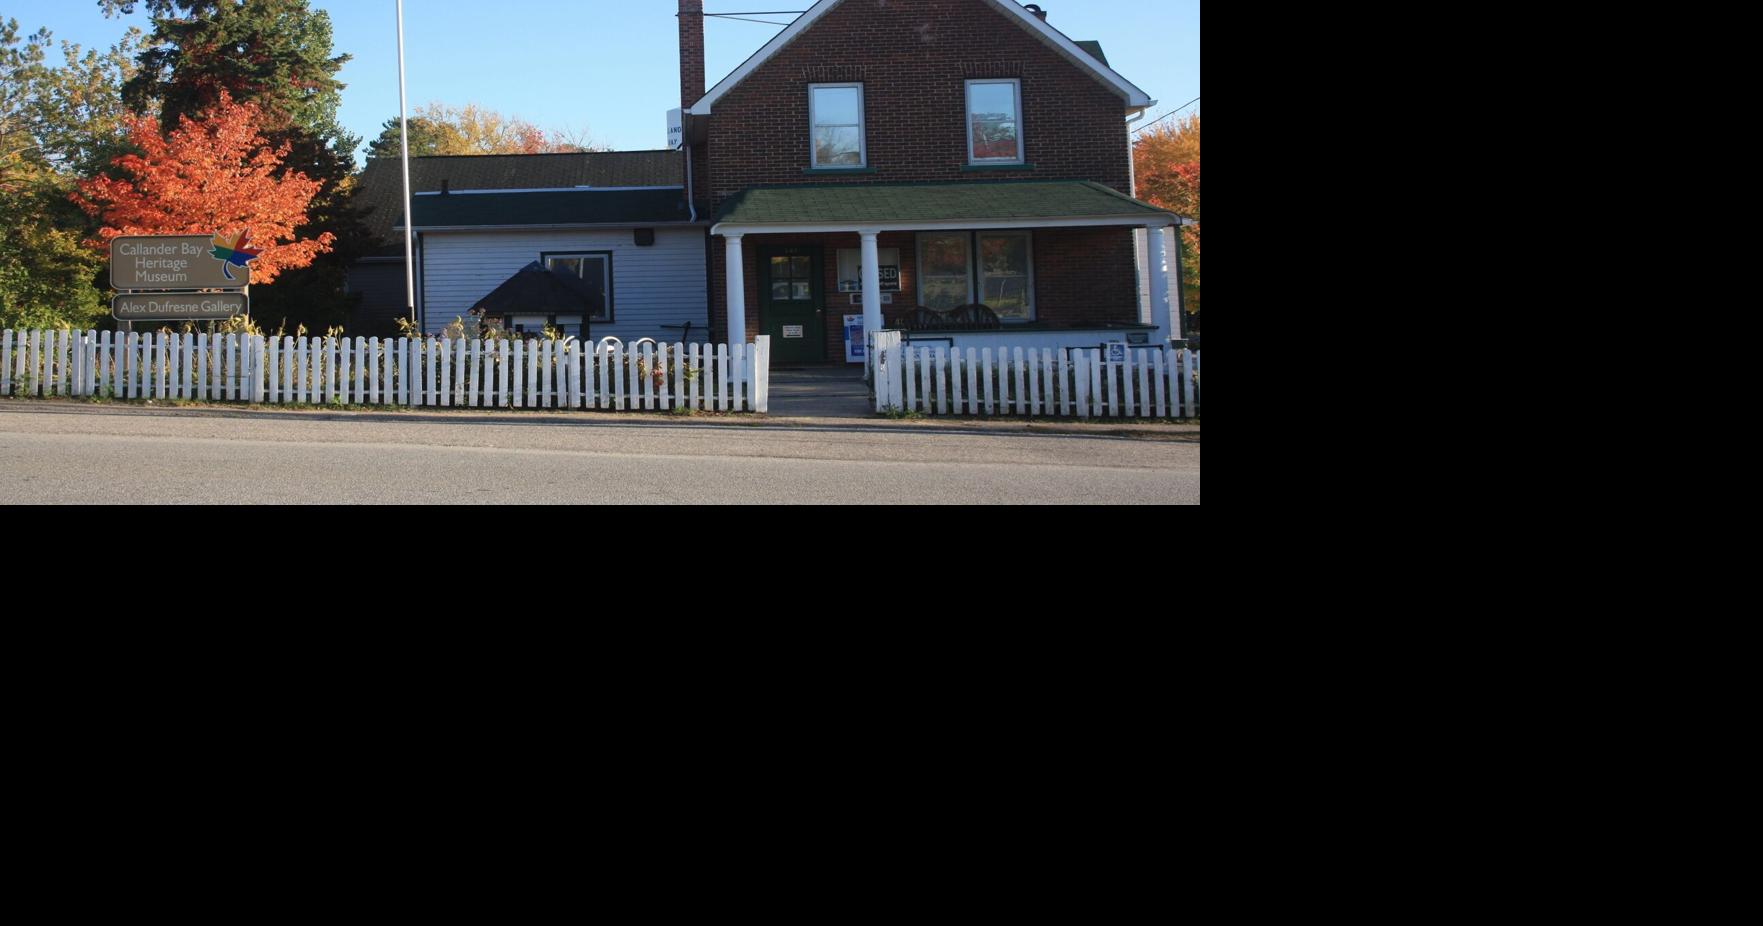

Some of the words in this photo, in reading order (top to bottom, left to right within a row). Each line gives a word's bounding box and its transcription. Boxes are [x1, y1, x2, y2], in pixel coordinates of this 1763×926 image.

[120, 243, 177, 256] Callander
[181, 242, 203, 258] Bay
[135, 257, 187, 271] Heritage
[135, 270, 187, 282] Museum
[858, 267, 897, 279] CSED
[120, 302, 146, 313] Alex
[148, 301, 198, 313] Dufresne
[200, 300, 242, 314] Gallery
